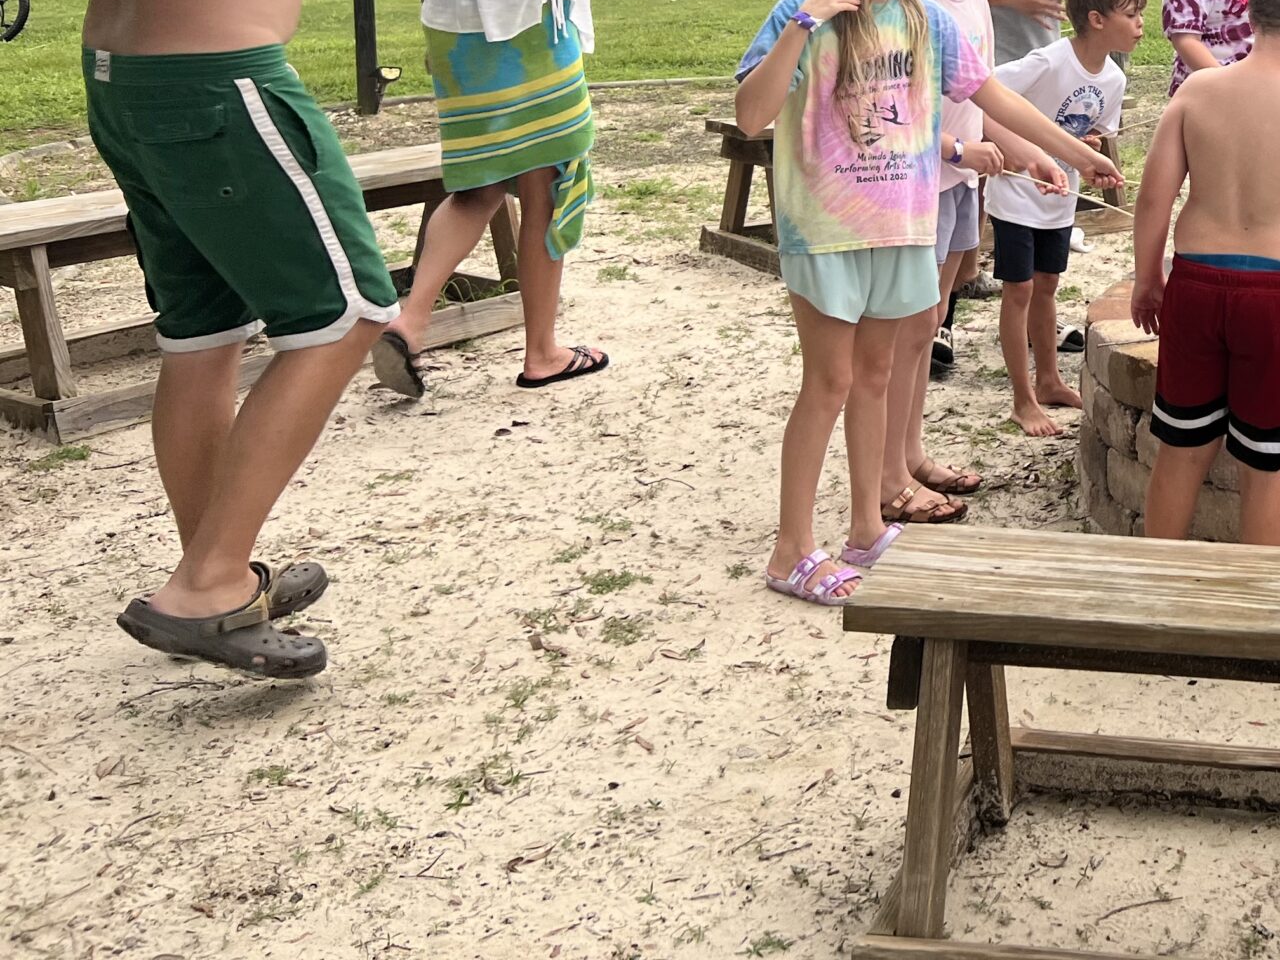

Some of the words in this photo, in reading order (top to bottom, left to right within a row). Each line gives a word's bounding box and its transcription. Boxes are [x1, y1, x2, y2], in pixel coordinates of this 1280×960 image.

[1055, 96, 1073, 124] FIRST
[1073, 86, 1086, 98] ON
[1088, 86, 1102, 98] THE
[884, 161, 901, 171] Arts
[856, 174, 887, 182] Recital
